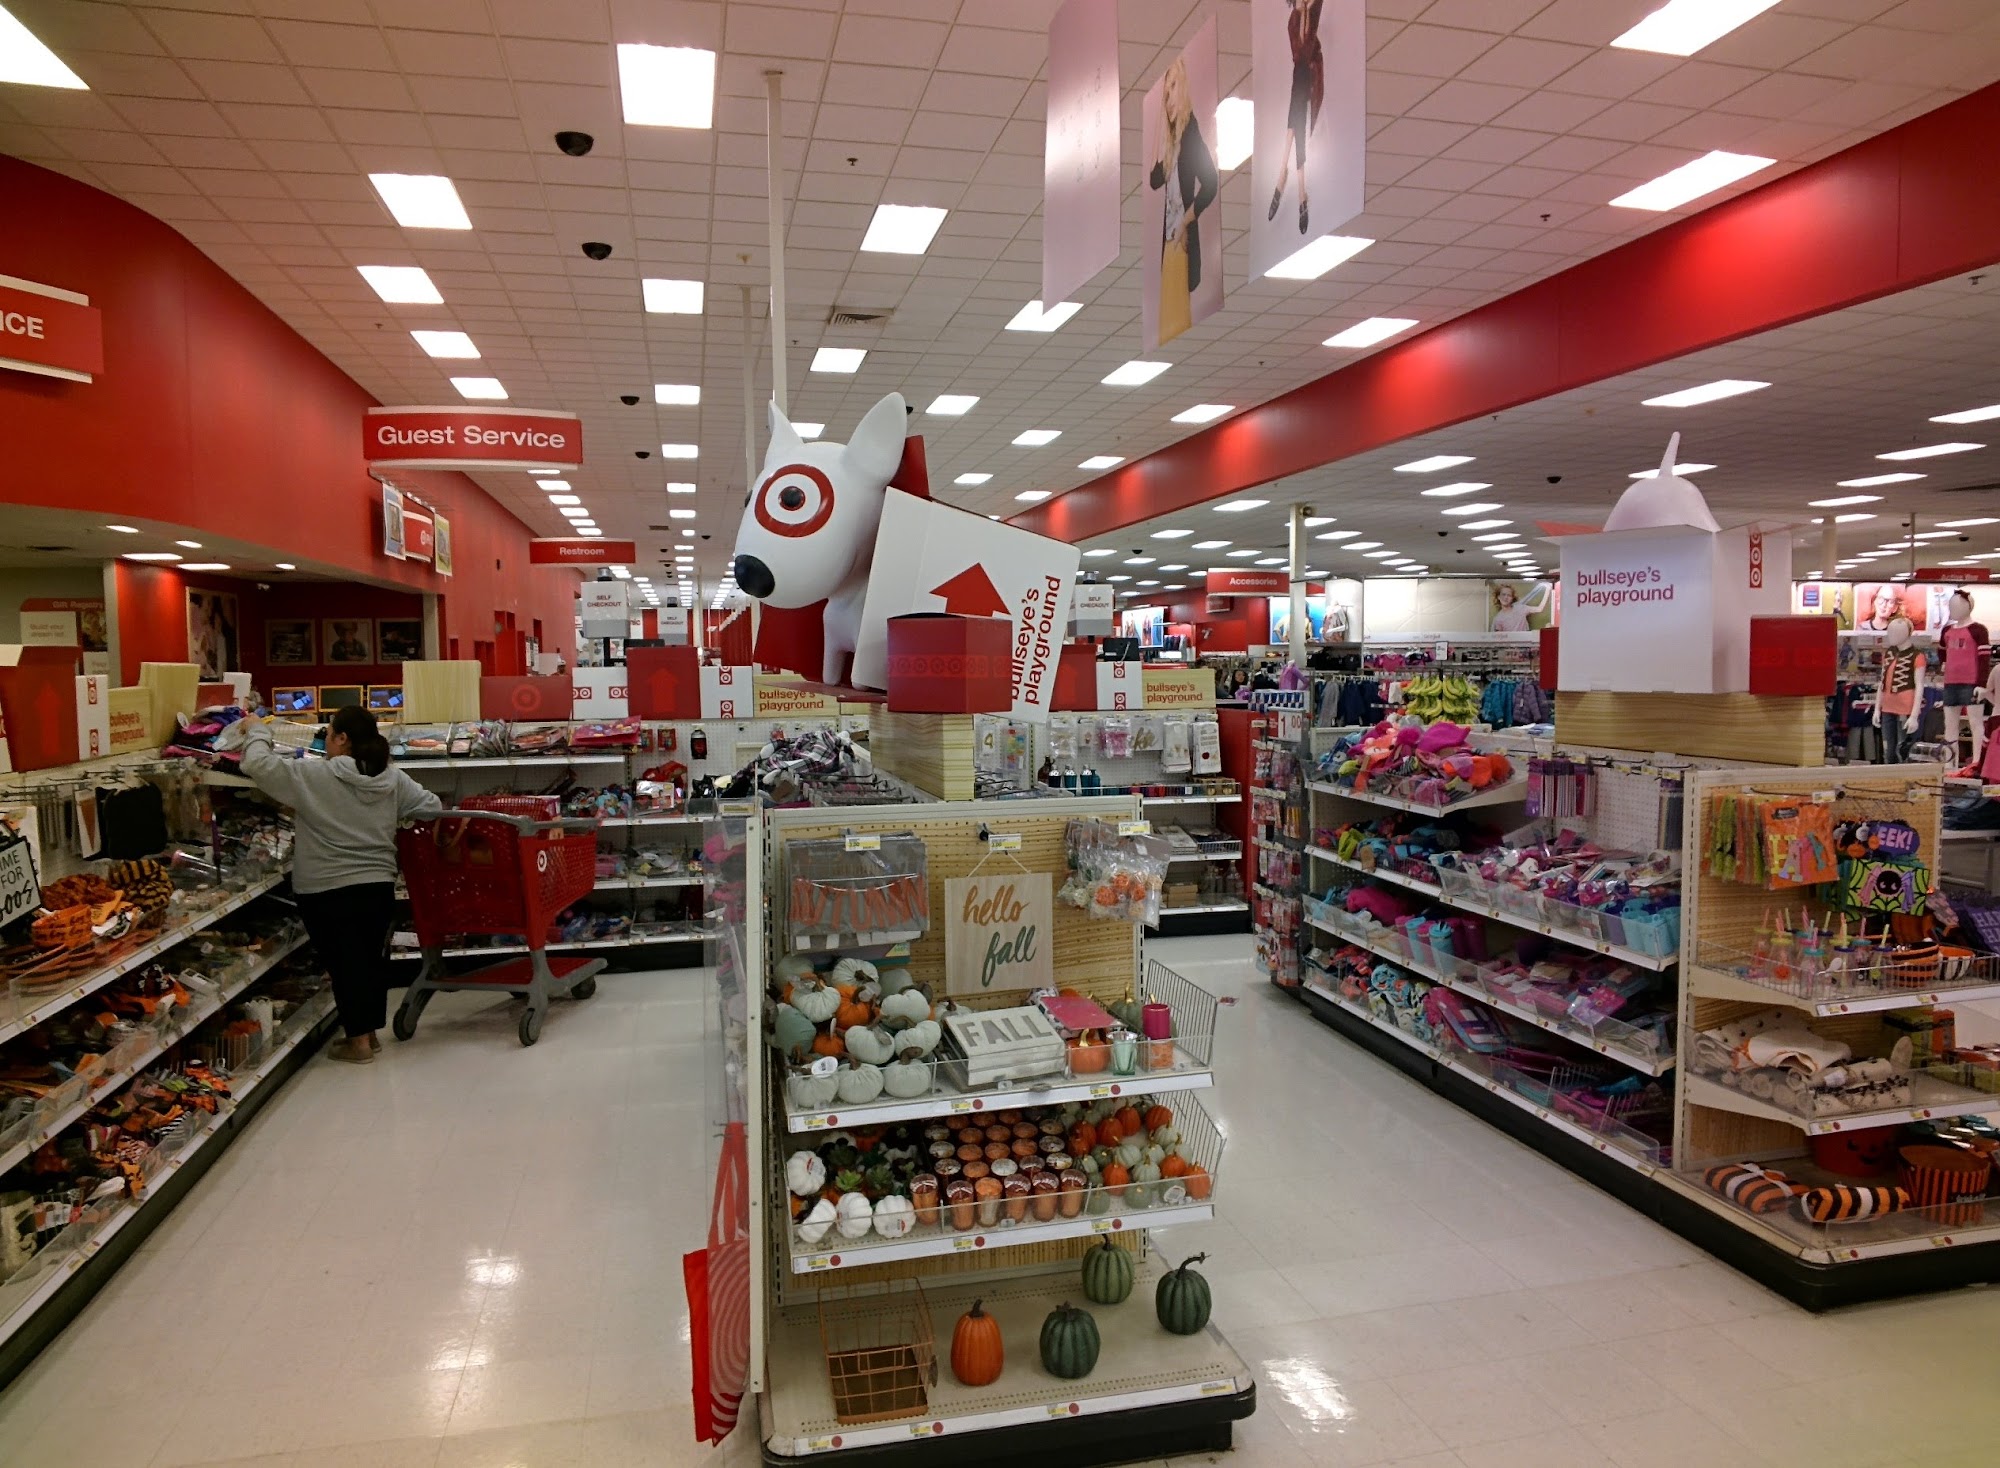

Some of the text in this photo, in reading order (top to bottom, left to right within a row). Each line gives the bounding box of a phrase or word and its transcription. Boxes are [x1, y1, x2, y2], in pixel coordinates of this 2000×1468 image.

[377, 425, 566, 449] Guest Service
[559, 546, 605, 556] Restroom
[1229, 577, 1278, 586] Accessories
[1577, 566, 1661, 587] bullseye's
[1577, 584, 1674, 607] playground
[1011, 588, 1039, 700] bullseye's
[1024, 575, 1061, 705] playground
[759, 690, 816, 703] bullseyes
[1146, 682, 1195, 693] bullseye's
[1147, 693, 1203, 704] playground
[759, 700, 824, 712] playground
[1878, 826, 1914, 850] EEK!
[1, 866, 24, 889] FOR
[789, 872, 928, 931] AUTUMN
[962, 884, 1030, 926] hello
[982, 925, 1037, 987] fall
[957, 1015, 1053, 1047] FALL
